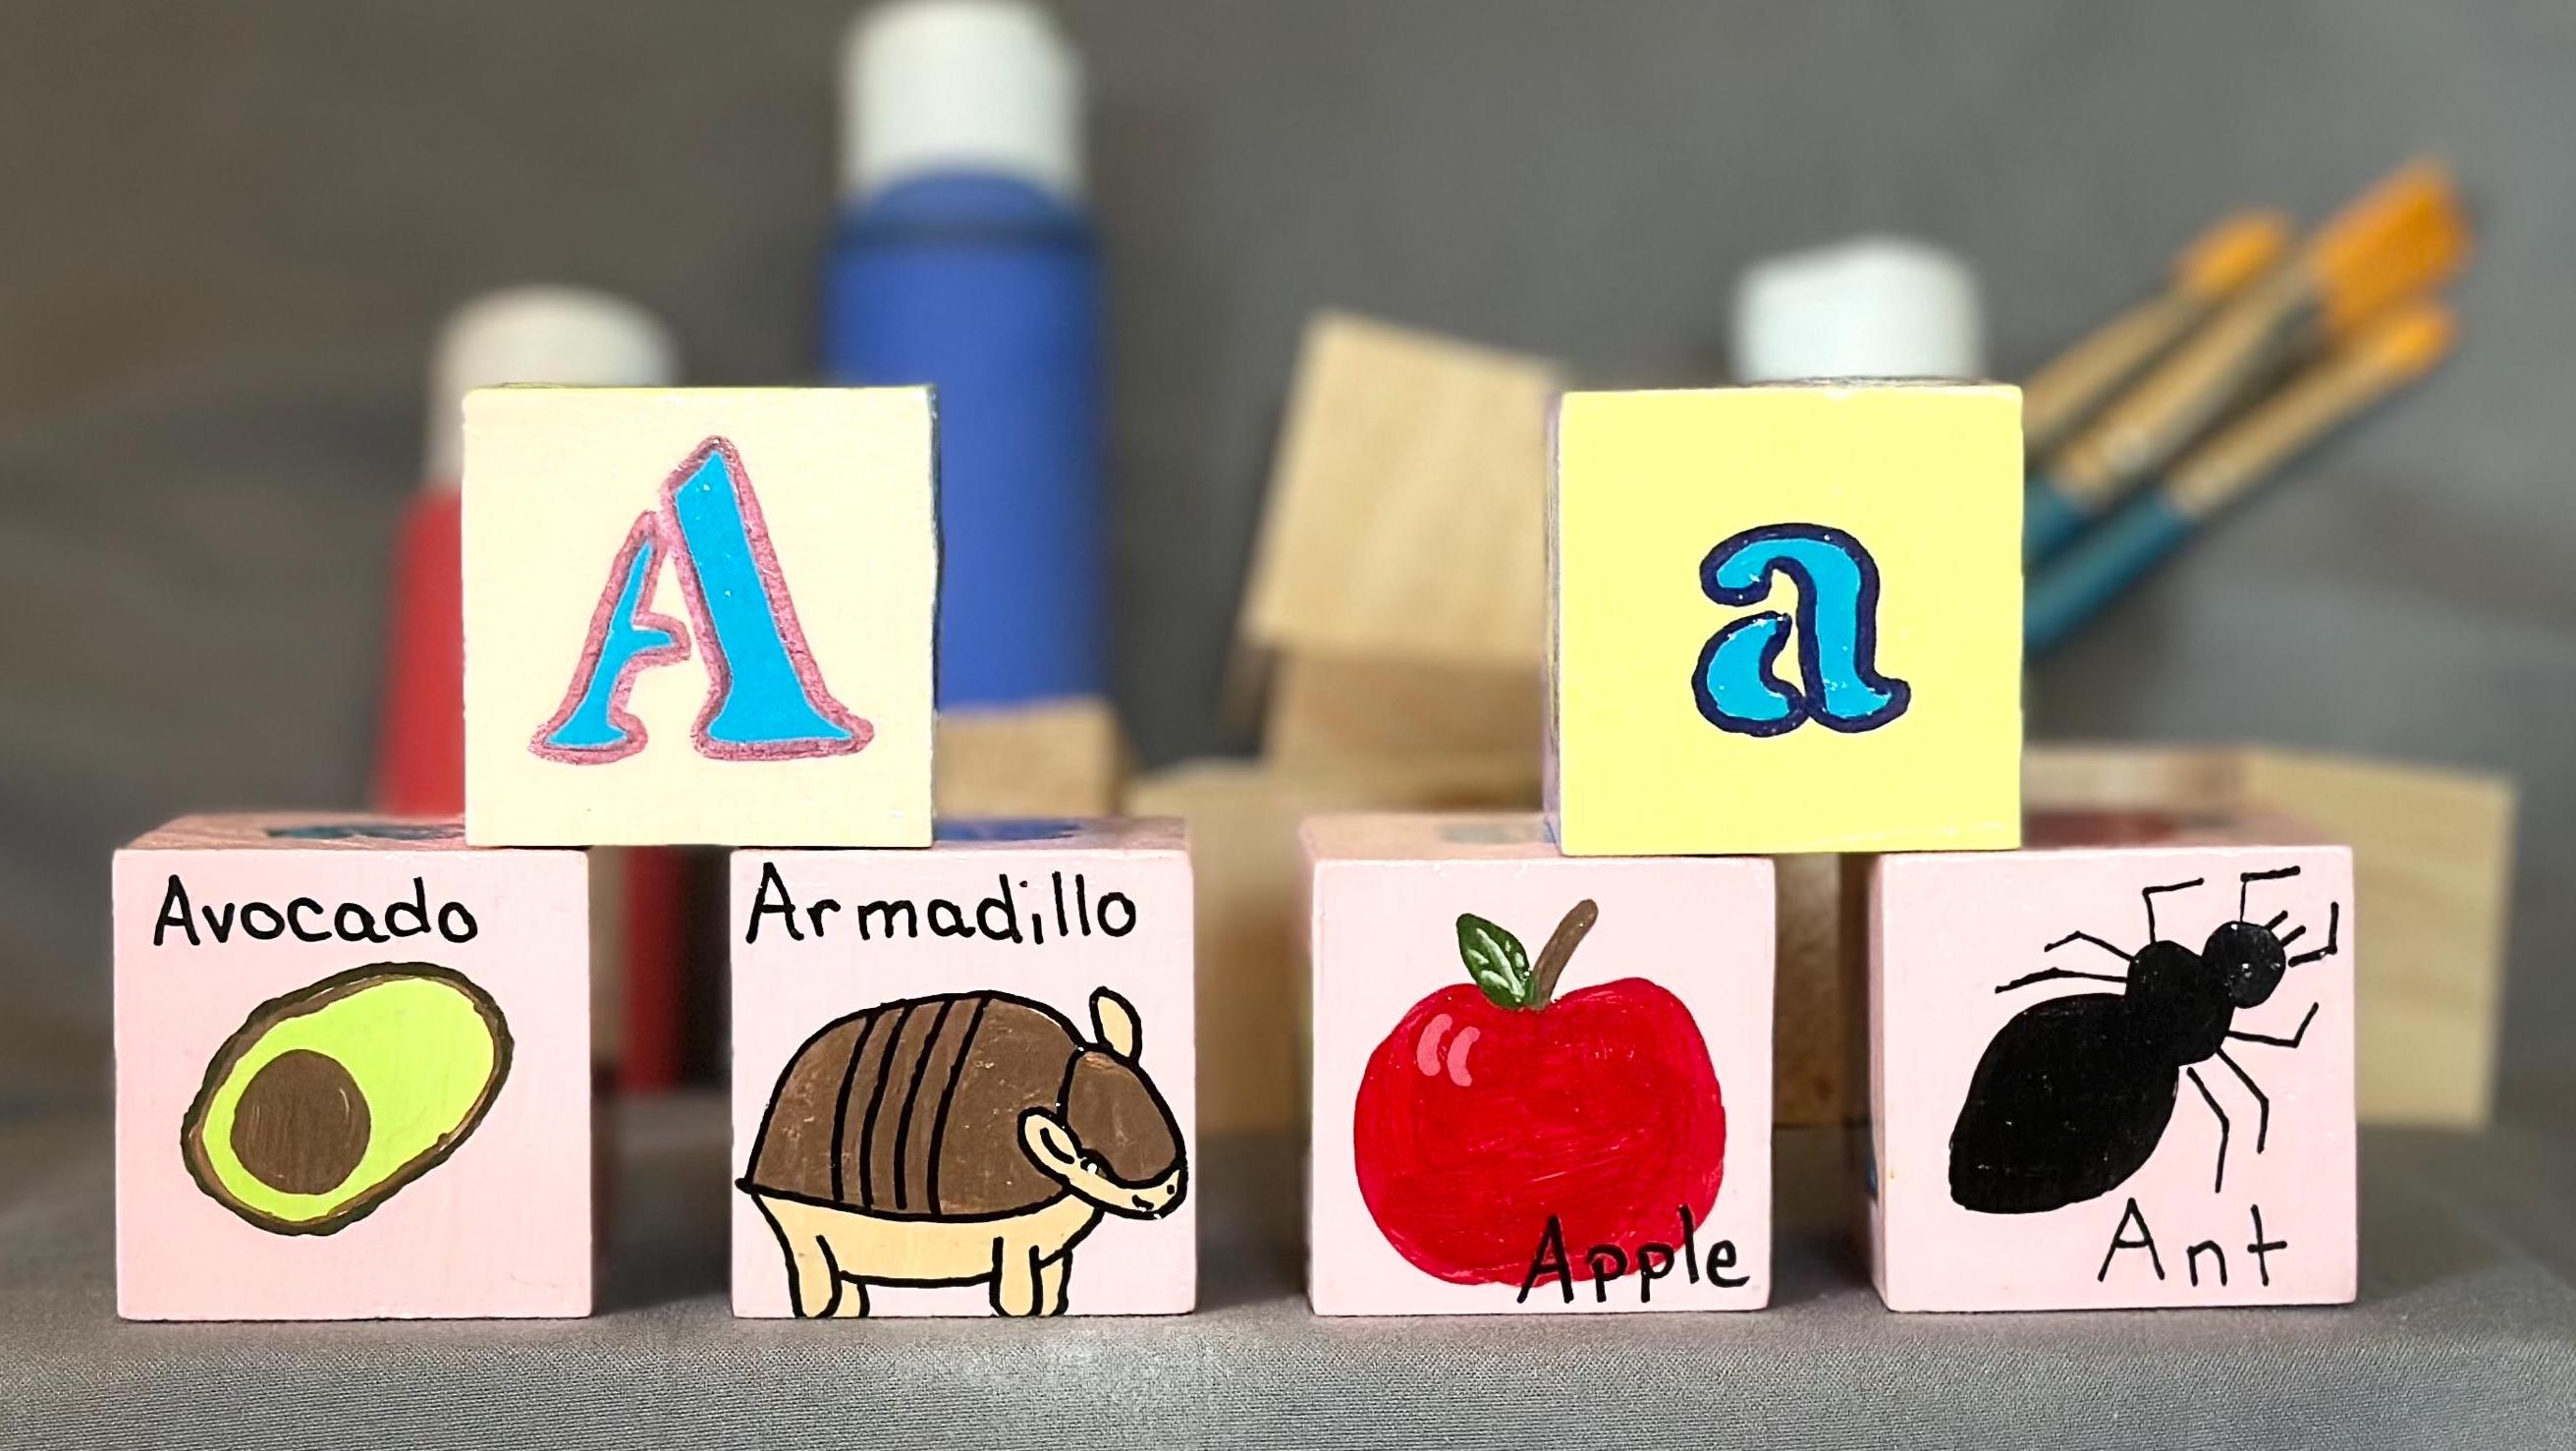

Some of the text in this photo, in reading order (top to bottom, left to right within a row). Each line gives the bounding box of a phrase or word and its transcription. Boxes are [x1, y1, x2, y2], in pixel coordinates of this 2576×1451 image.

[527, 434, 875, 765] A
[1690, 522, 1911, 738] a
[151, 873, 480, 947] Avocado
[745, 861, 1137, 946] Armadillo
[1516, 1204, 1751, 1305] Apple
[2096, 1198, 2289, 1288] Ant
